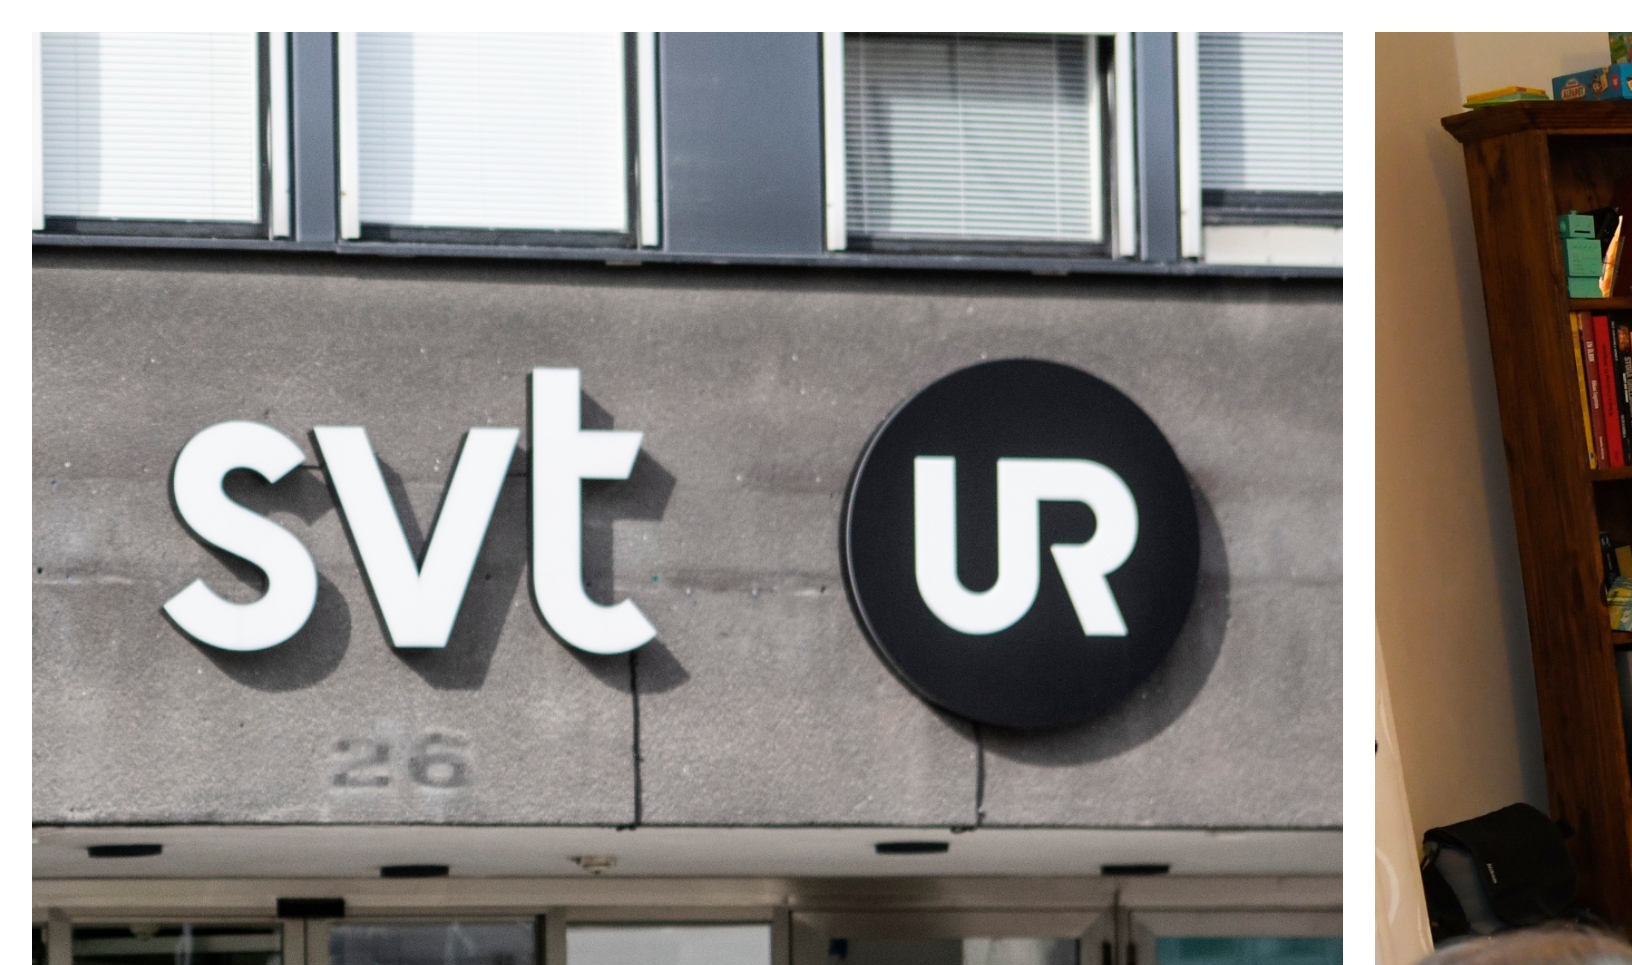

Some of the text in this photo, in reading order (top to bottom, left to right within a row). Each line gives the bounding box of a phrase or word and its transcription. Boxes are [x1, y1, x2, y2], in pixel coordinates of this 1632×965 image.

[162, 367, 658, 655] svt
[914, 455, 1140, 637] UR
[332, 731, 474, 790] 26
